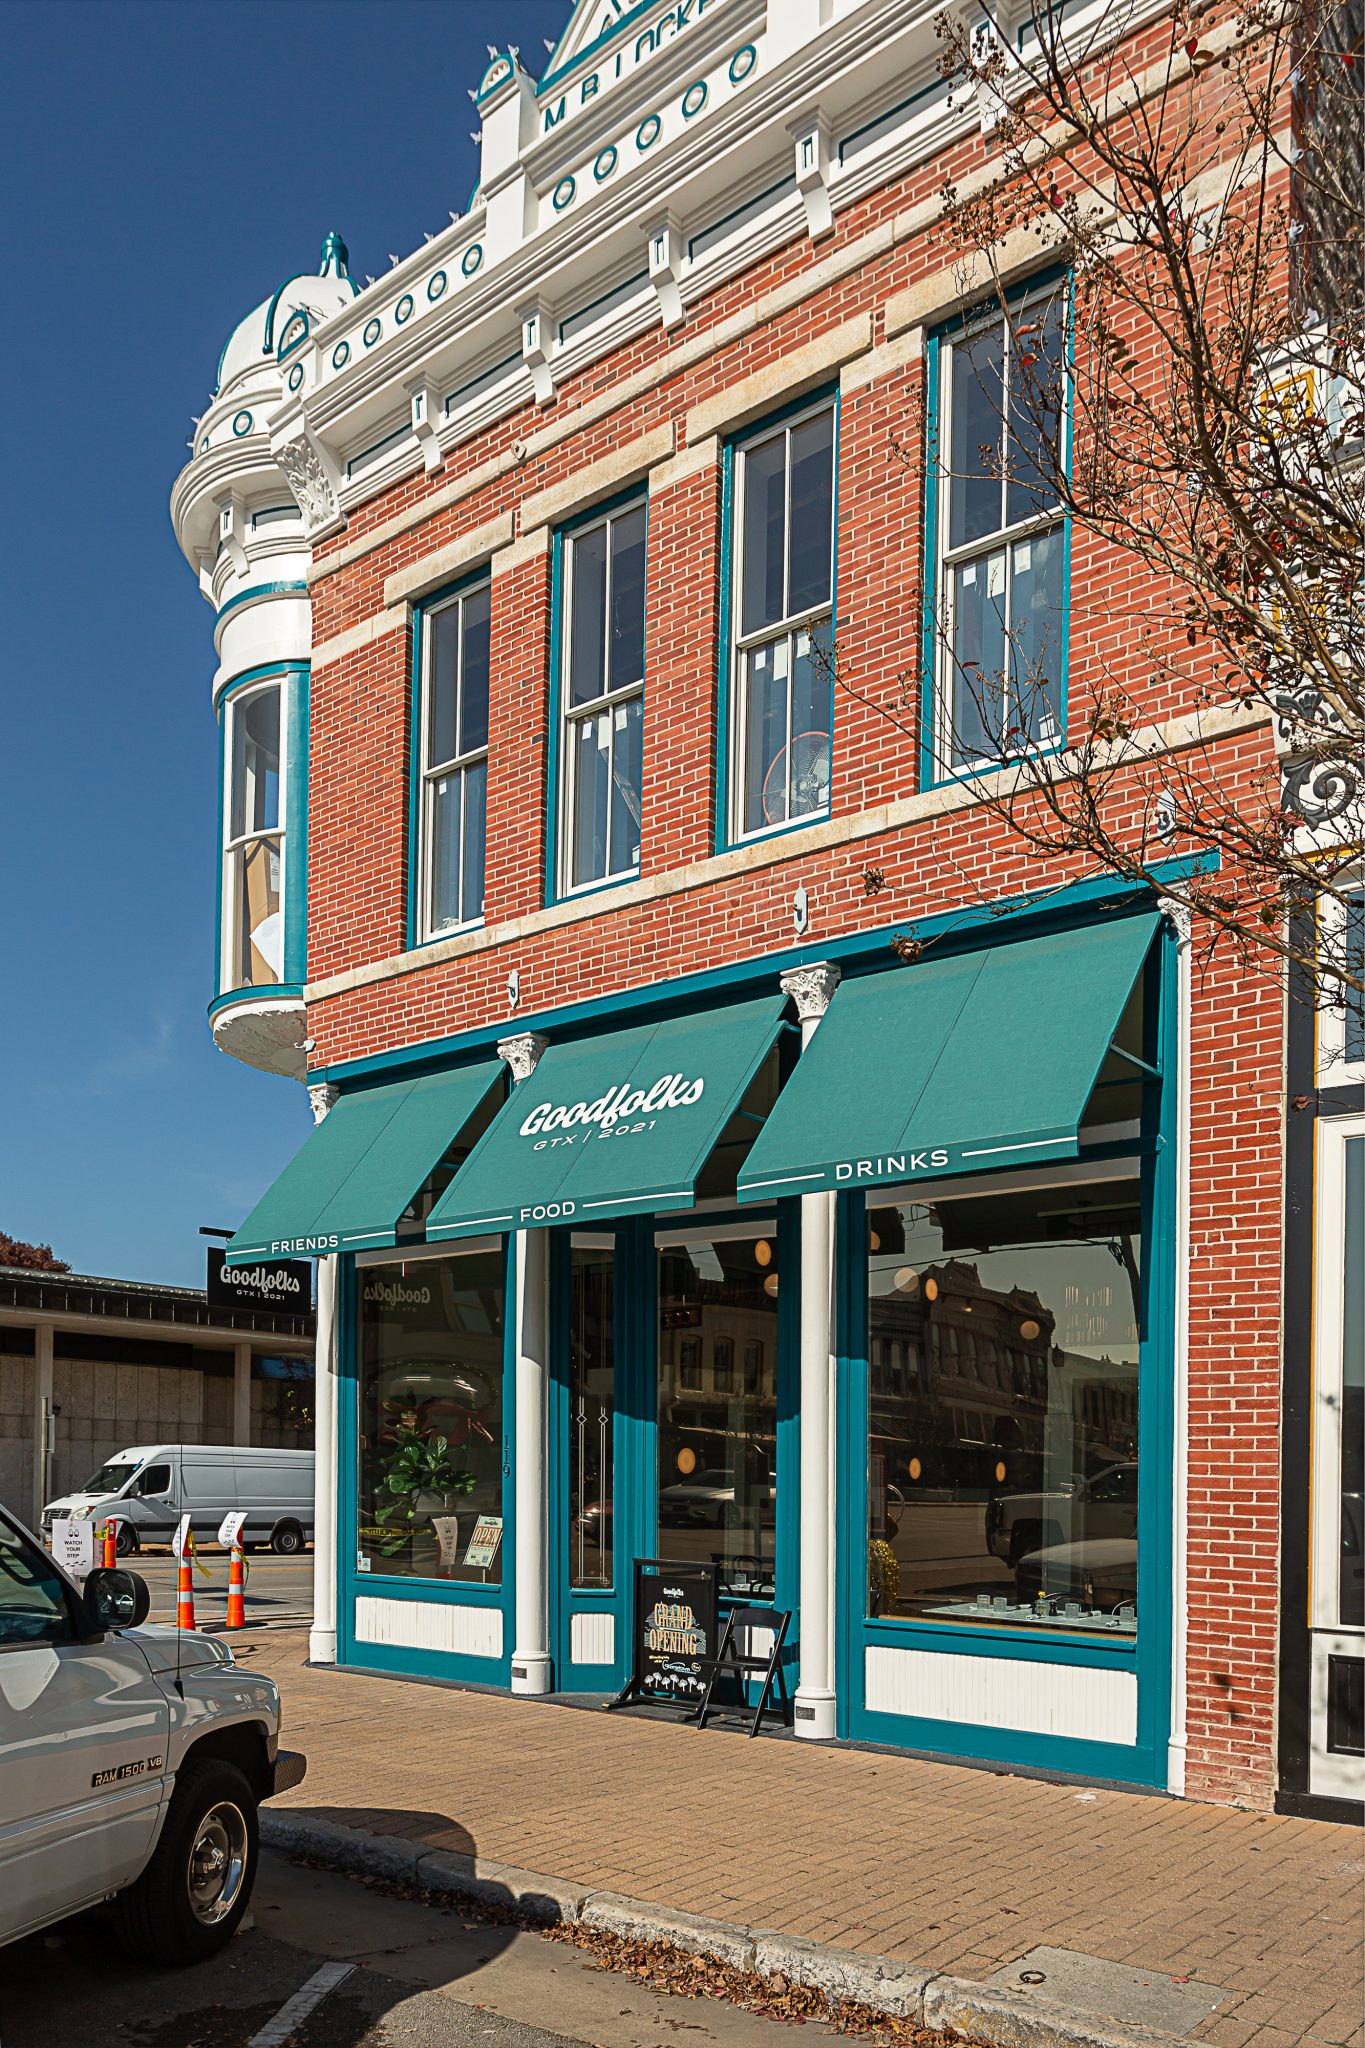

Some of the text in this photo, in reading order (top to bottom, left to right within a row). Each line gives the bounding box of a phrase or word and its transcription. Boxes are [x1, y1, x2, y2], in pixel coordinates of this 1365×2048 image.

[519, 1073, 704, 1136] Goodfolks
[533, 1134, 577, 1150] GTX
[598, 1119, 657, 1139] 2021
[835, 1149, 949, 1180] DRINKS
[520, 1201, 575, 1222] FOOD
[271, 1235, 339, 1254] FRIENDS
[220, 1264, 300, 1293] Goodfolks
[236, 1289, 255, 1297] GTX
[472, 1527, 501, 1547] OPEN
[654, 1602, 693, 1630] GRAND
[649, 1628, 697, 1655] OPENING
[95, 1756, 162, 1786] RAM 1500 V8
